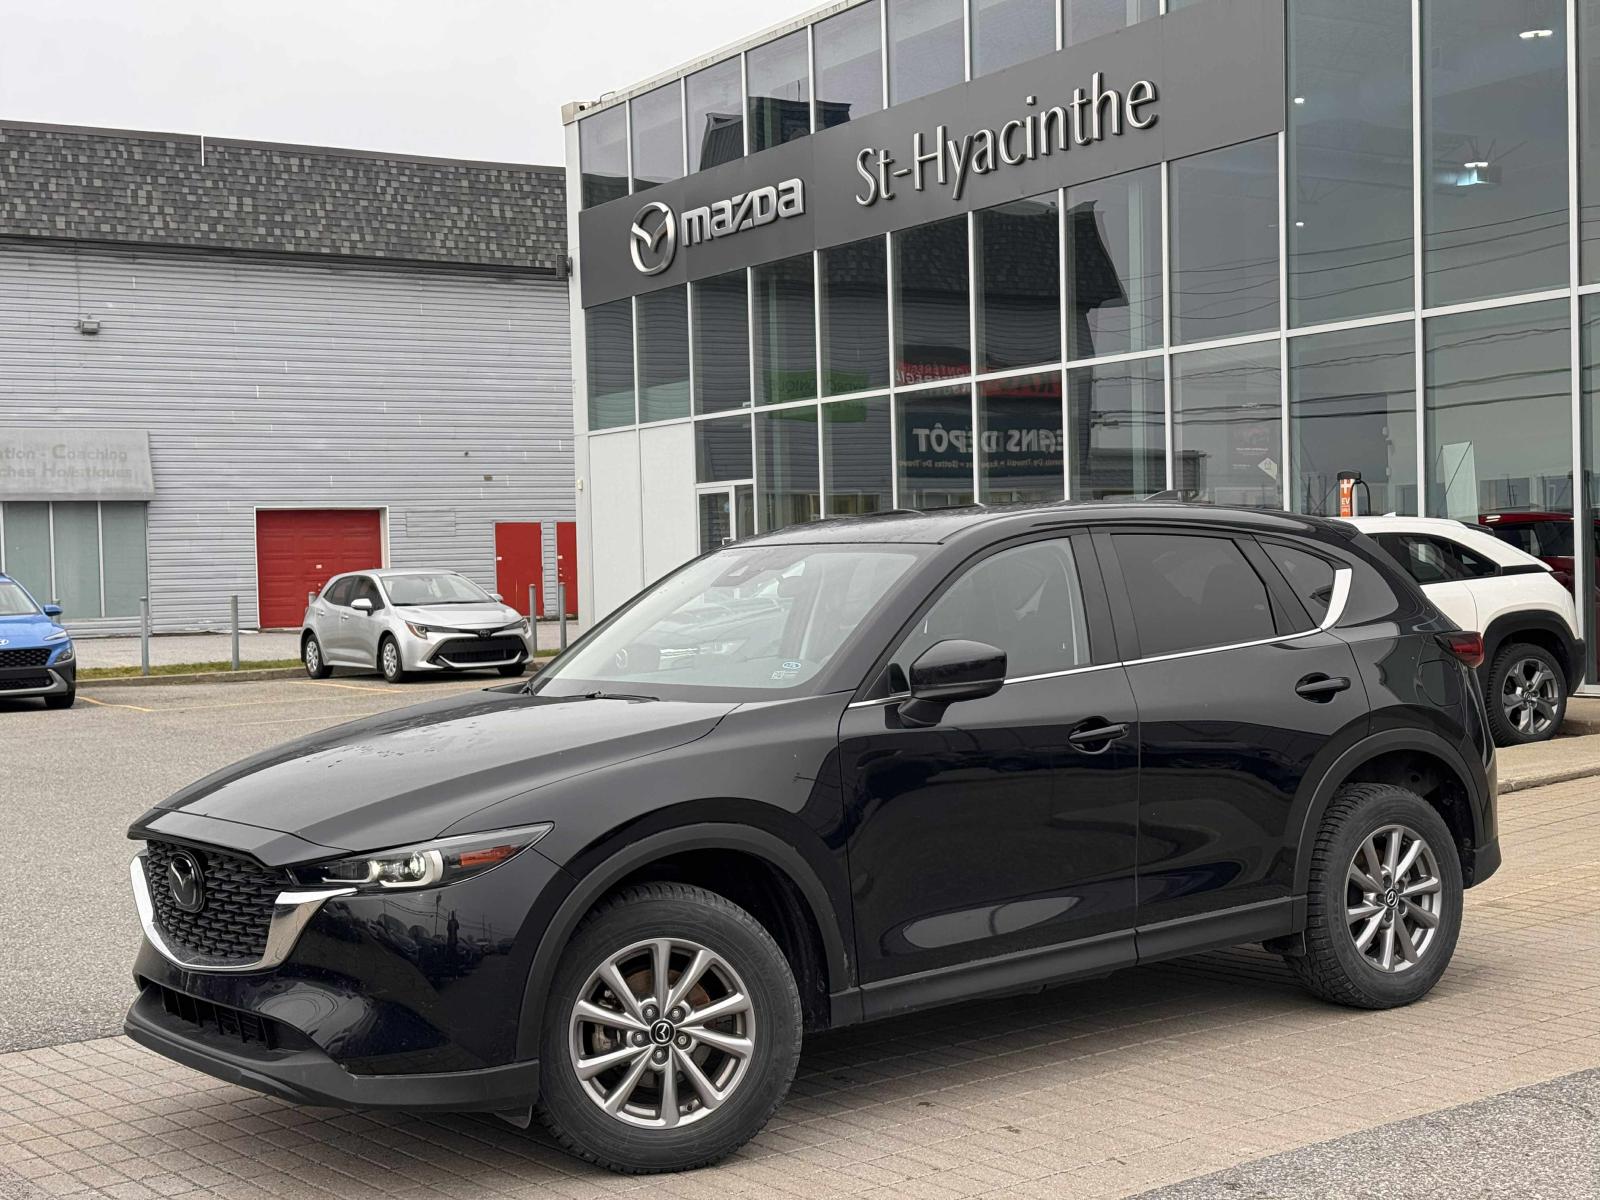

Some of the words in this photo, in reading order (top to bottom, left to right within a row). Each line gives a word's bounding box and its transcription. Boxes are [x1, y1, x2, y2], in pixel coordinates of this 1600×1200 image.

[856, 71, 1158, 207] St-Hyacinthe
[681, 178, 804, 247] mazda
[0, 446, 35, 460] tion
[52, 444, 128, 462] Coaching
[1341, 497, 1351, 505] EV
